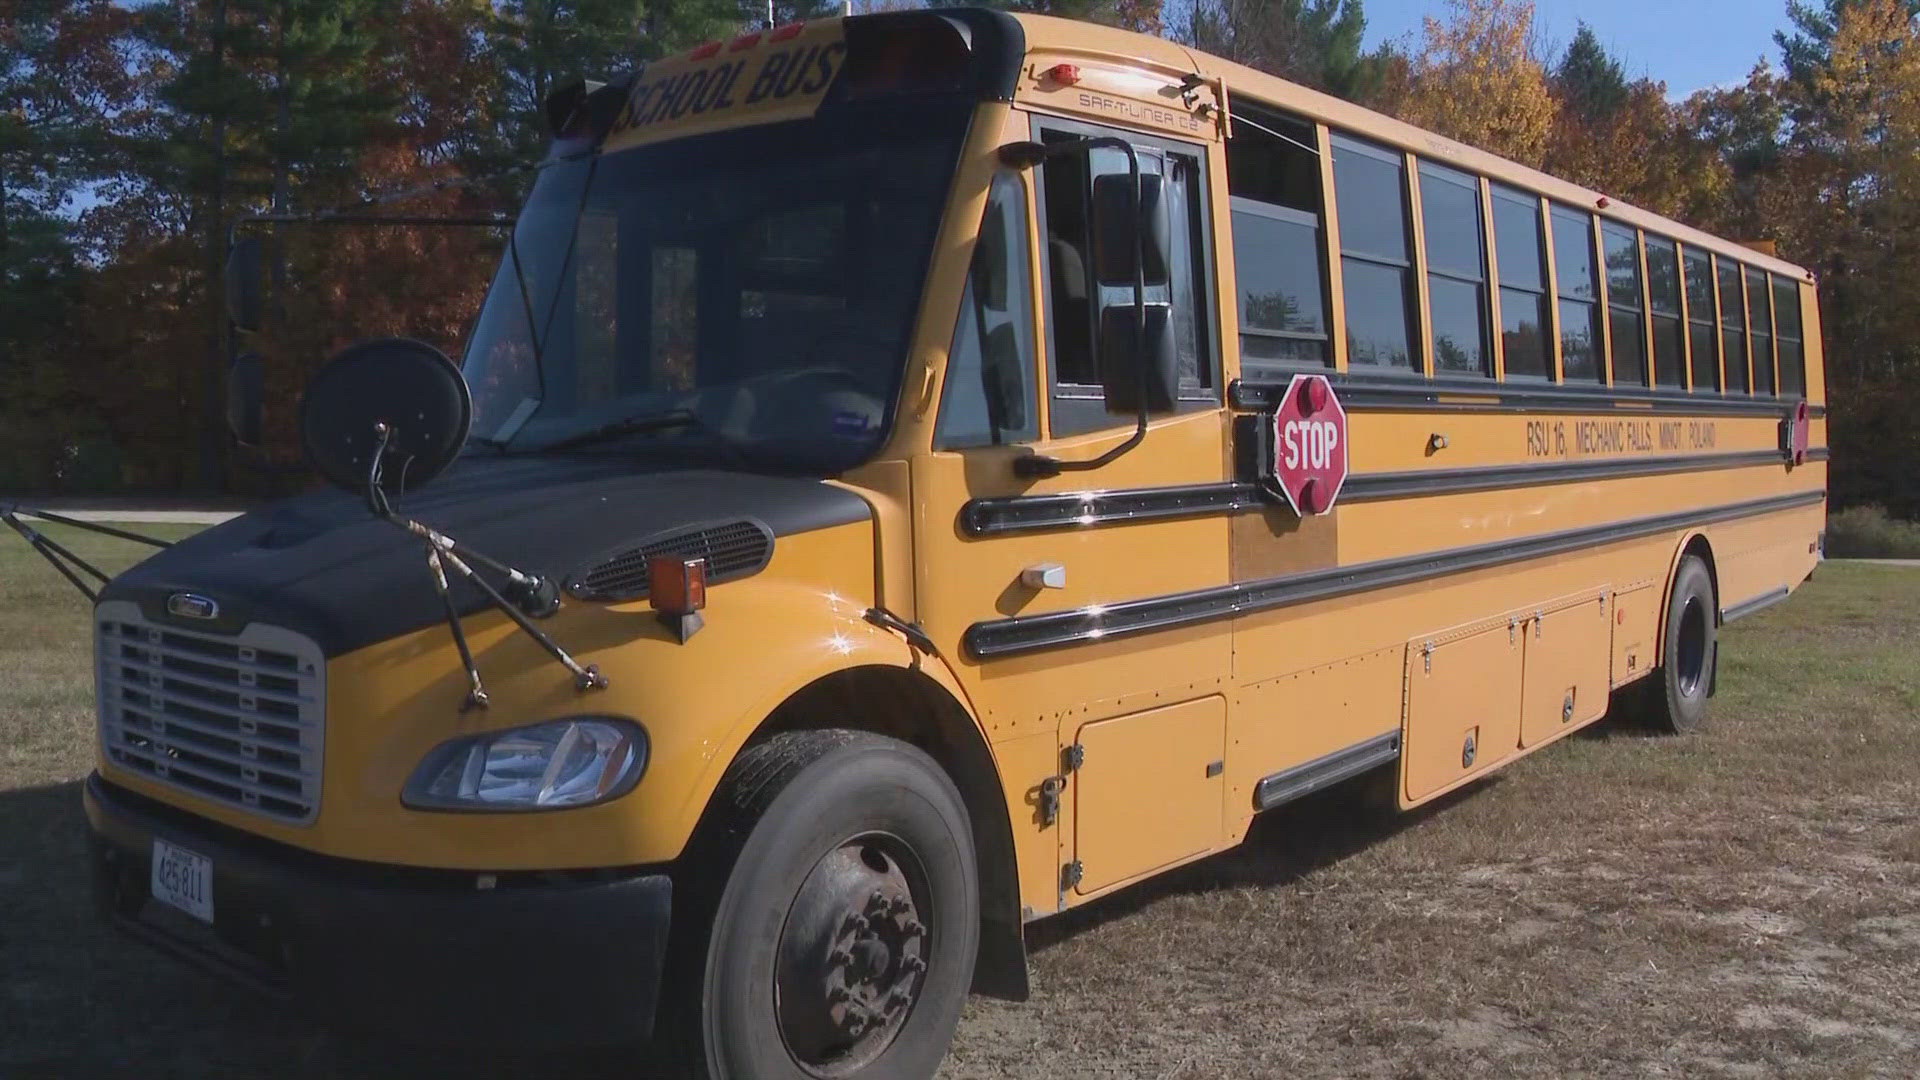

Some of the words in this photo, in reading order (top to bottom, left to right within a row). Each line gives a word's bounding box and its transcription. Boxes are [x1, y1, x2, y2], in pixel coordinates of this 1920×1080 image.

[612, 59, 746, 133] SCHOOL
[746, 40, 847, 104] BUS
[1179, 116, 1199, 132] C2
[1284, 420, 1338, 471] STOP
[1527, 421, 1550, 456] RSU
[1575, 421, 1625, 454] MECHANIC
[1689, 421, 1716, 449] POLAND
